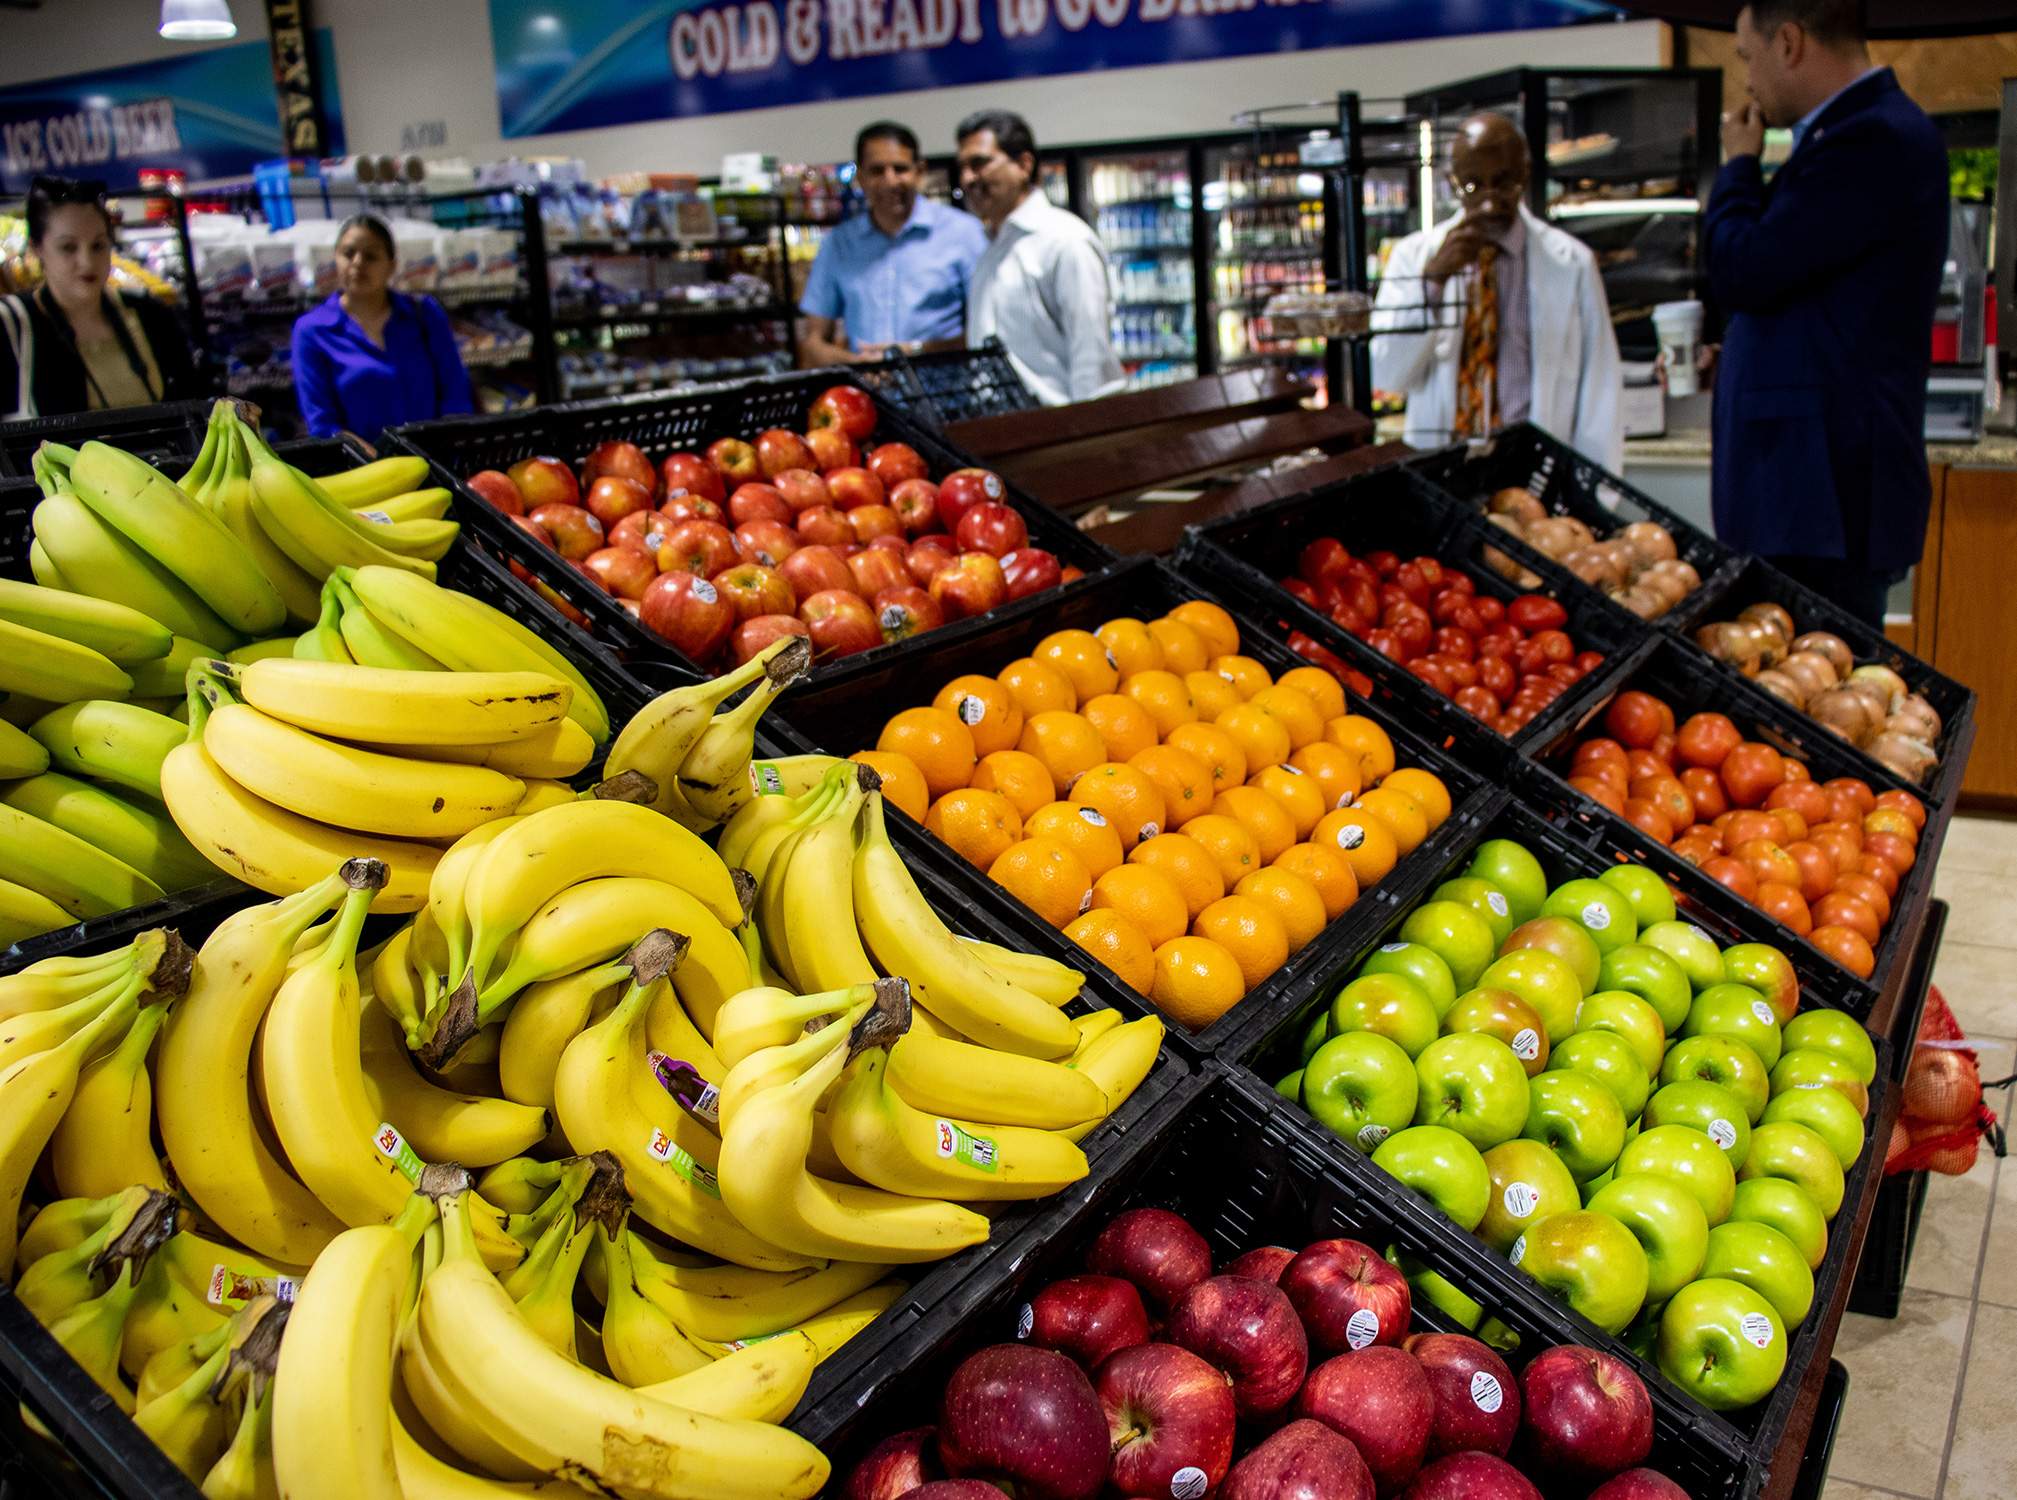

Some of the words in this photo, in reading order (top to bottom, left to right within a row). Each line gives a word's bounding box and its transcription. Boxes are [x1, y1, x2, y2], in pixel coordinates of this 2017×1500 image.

[272, 0, 318, 150] TEXAS
[669, 1, 781, 79] COLD
[785, 0, 821, 65] &
[828, 0, 983, 60] READY
[3, 119, 47, 176] ICE
[46, 110, 110, 168] COLD
[111, 99, 182, 159] BEER
[379, 1129, 396, 1151] Dole
[653, 1132, 669, 1155] Dol
